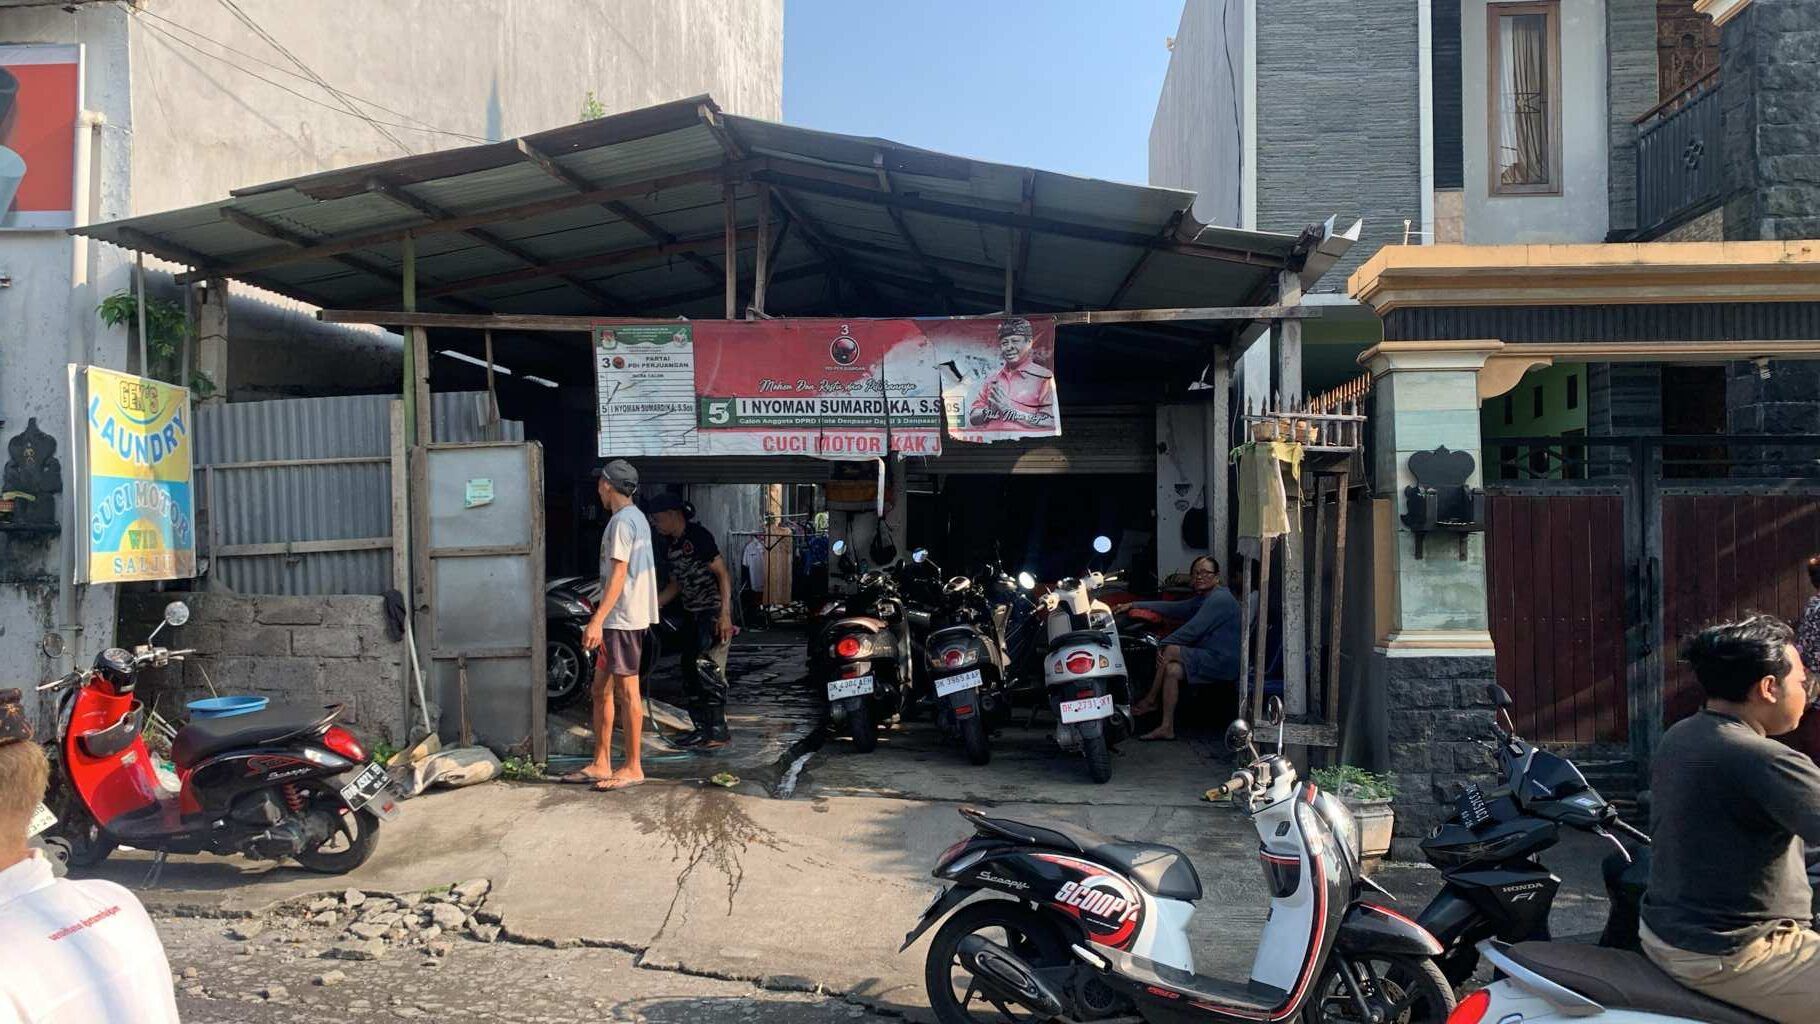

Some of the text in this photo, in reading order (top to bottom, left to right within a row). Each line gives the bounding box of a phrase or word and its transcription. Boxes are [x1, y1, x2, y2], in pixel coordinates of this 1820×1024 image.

[840, 325, 850, 335] 3
[602, 358, 611, 369] 3
[602, 404, 608, 413] 5
[707, 402, 730, 425] 5
[742, 400, 747, 414] I
[752, 400, 816, 414] NYOMAN
[762, 418, 793, 426] Anggota
[88, 396, 186, 464] LAUNDRY
[763, 435, 807, 452] CUCI
[814, 436, 881, 452] MOTOR
[890, 435, 927, 451] KAK
[92, 480, 190, 545] CUCI MOTOR
[976, 871, 1031, 890] Scoopy
[1502, 882, 1544, 892] HONDA
[1054, 881, 1142, 923] SCOOPY
